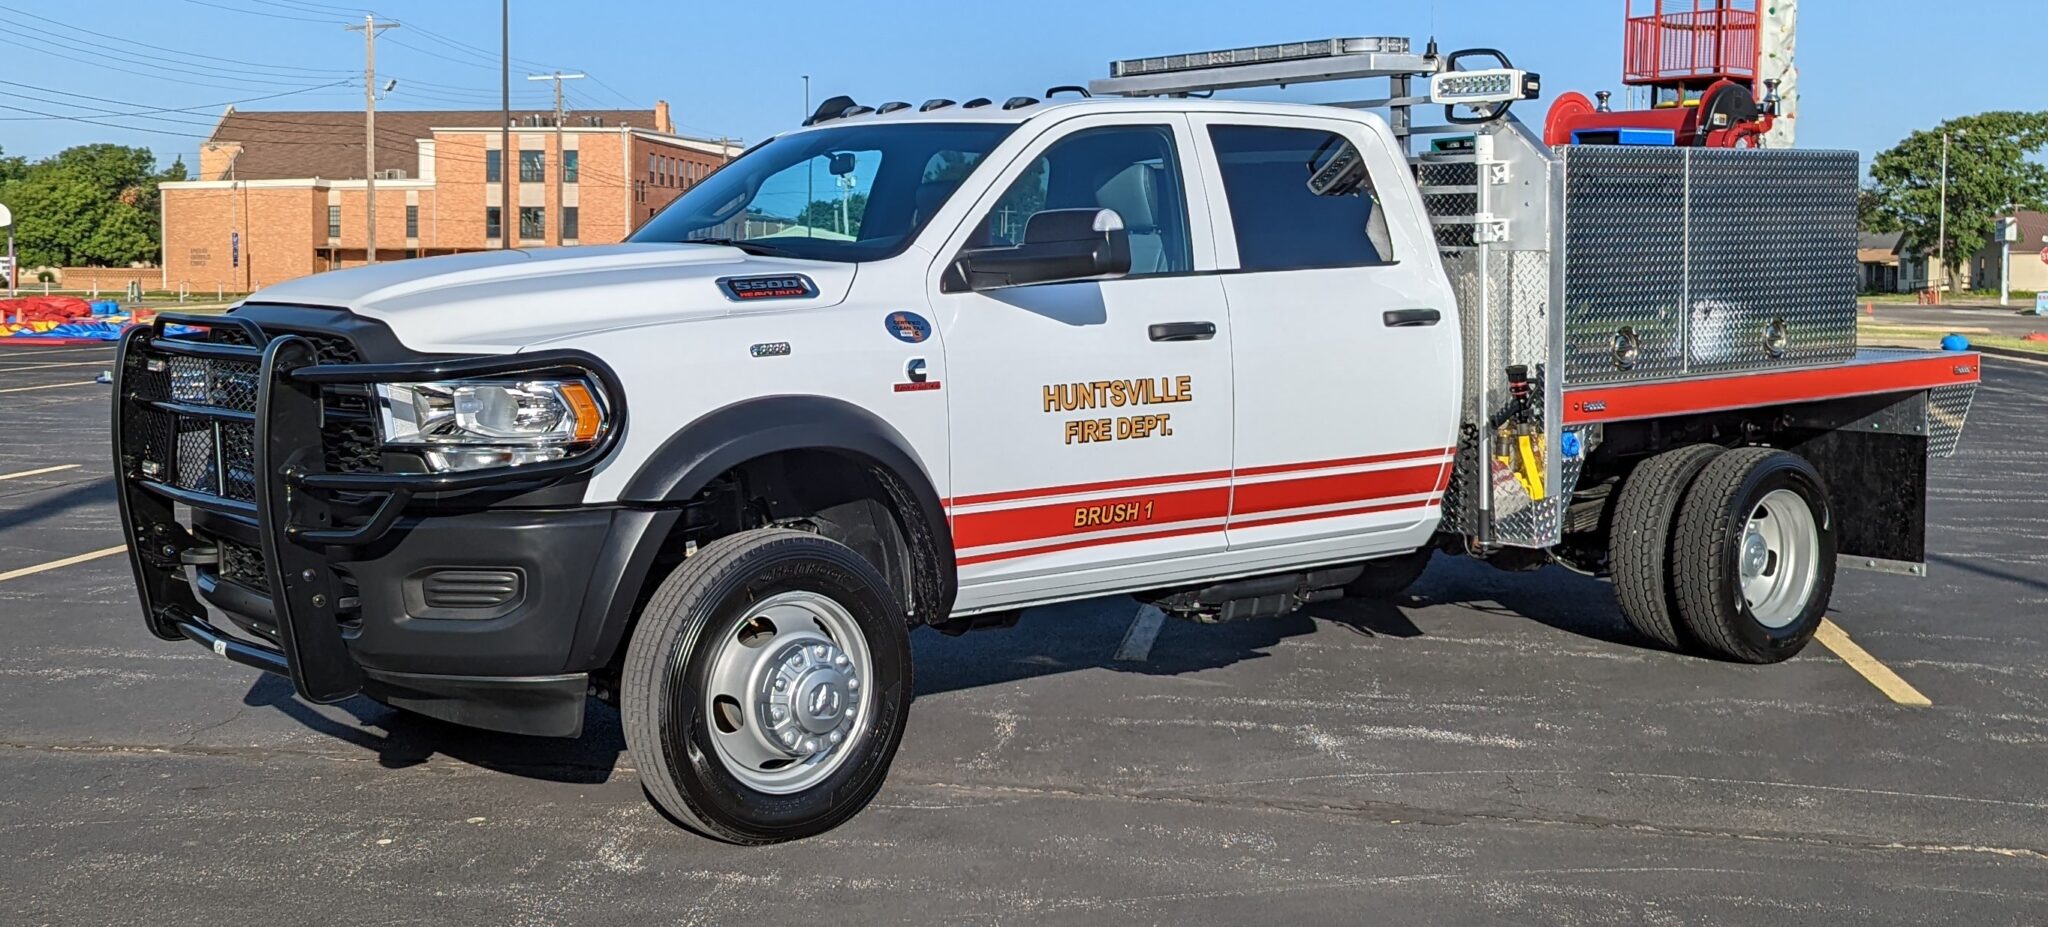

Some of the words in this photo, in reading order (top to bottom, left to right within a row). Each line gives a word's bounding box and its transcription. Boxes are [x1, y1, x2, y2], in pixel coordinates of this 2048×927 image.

[734, 280, 798, 290] 5500
[740, 290, 773, 298] HEAVY
[1043, 375, 1193, 412] HUNTSVILLE
[1065, 418, 1112, 445] FIRE
[1116, 413, 1173, 440] DEPT.
[1074, 501, 1140, 527] BRUSH
[1144, 499, 1154, 519] 1
